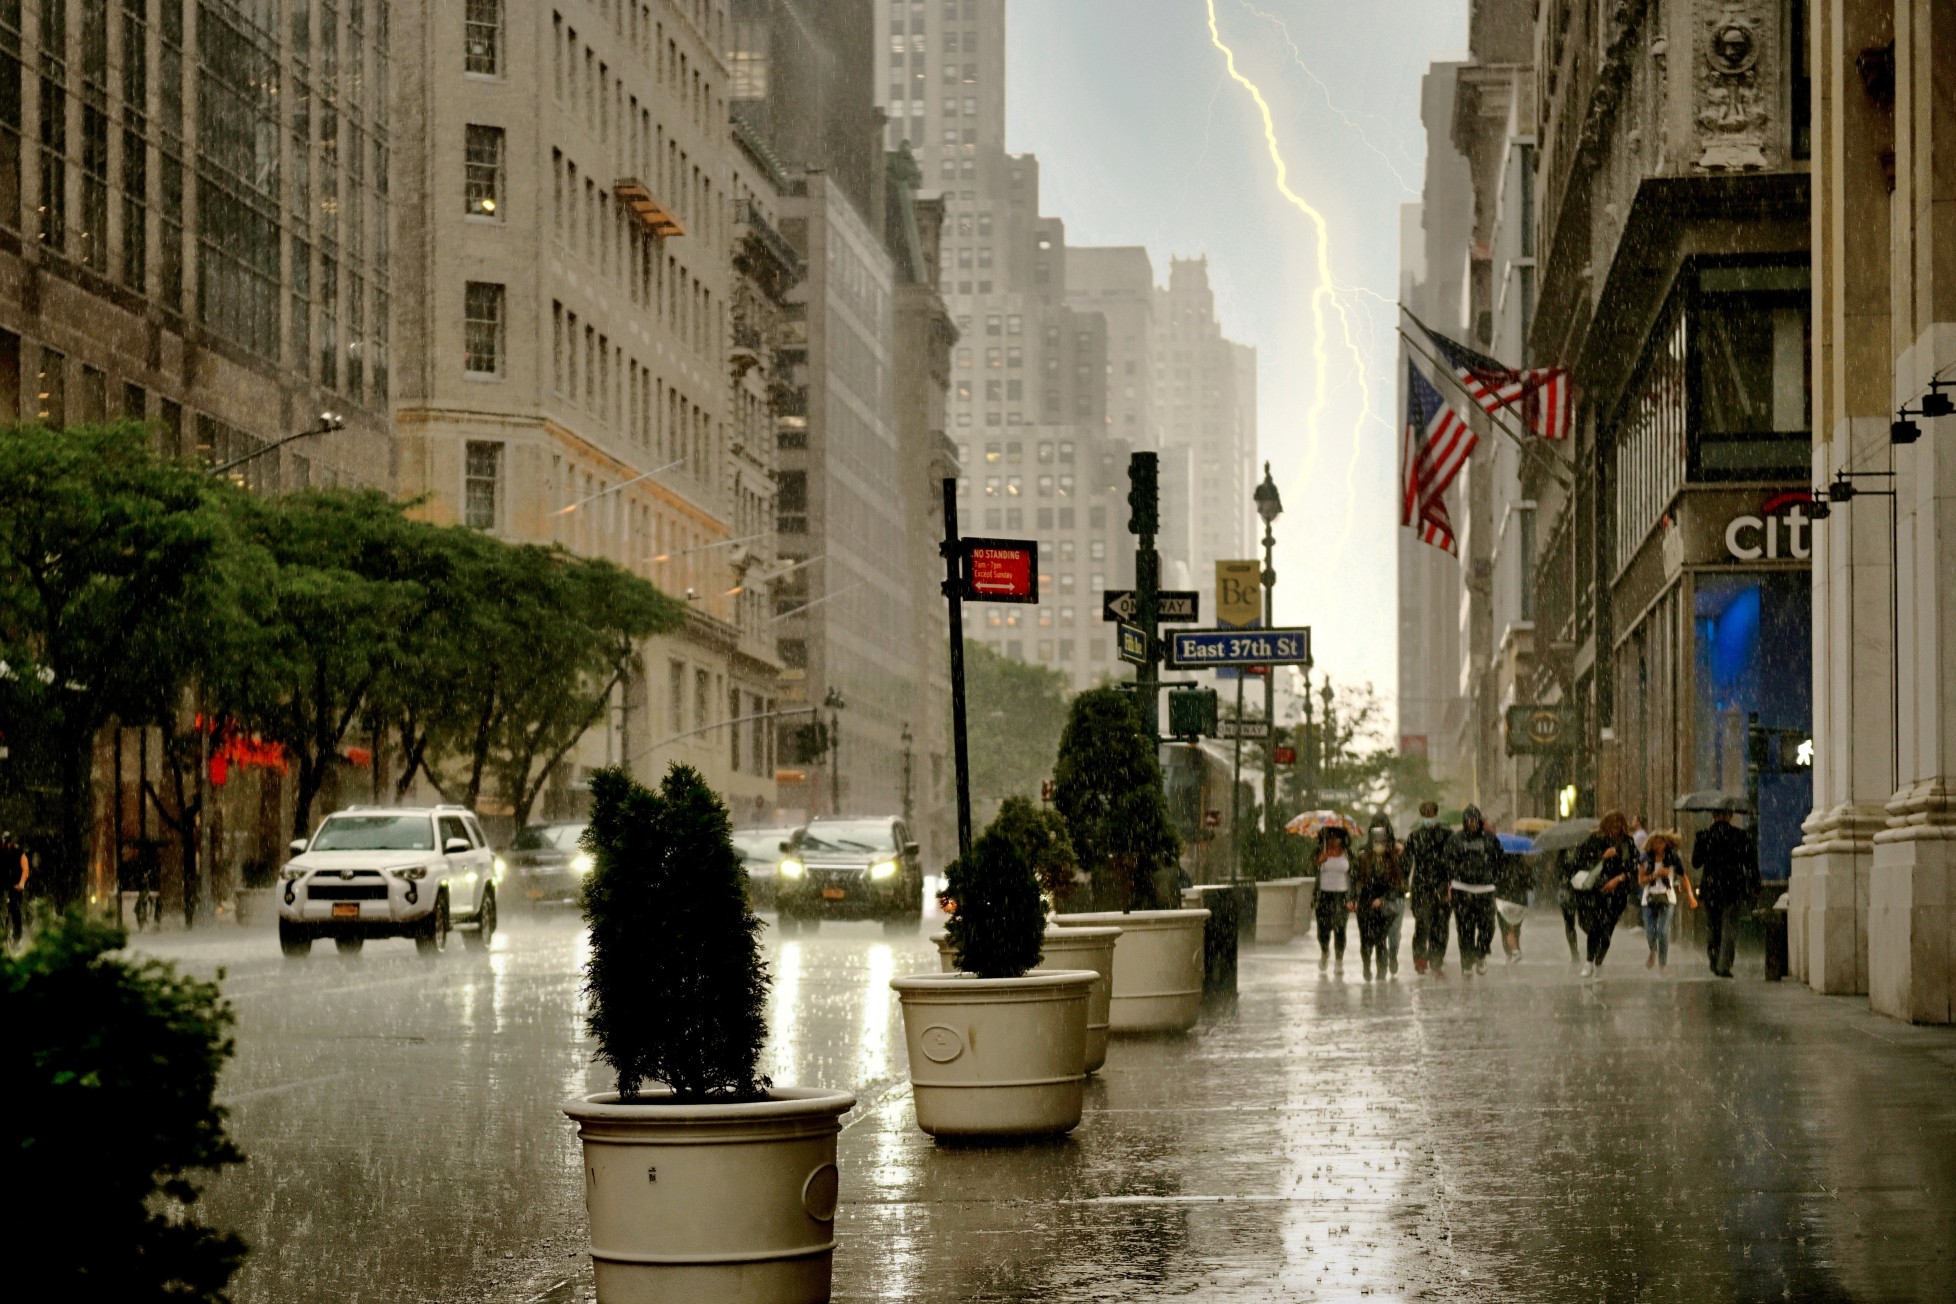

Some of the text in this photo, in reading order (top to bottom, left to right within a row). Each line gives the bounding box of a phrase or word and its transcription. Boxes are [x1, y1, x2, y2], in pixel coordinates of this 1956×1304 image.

[1725, 503, 1810, 559] cit
[973, 548, 1020, 560] NO STANDING
[974, 570, 1013, 580] Except Sunday
[1121, 600, 1137, 612] ON
[1182, 637, 1298, 658] East 37th St
